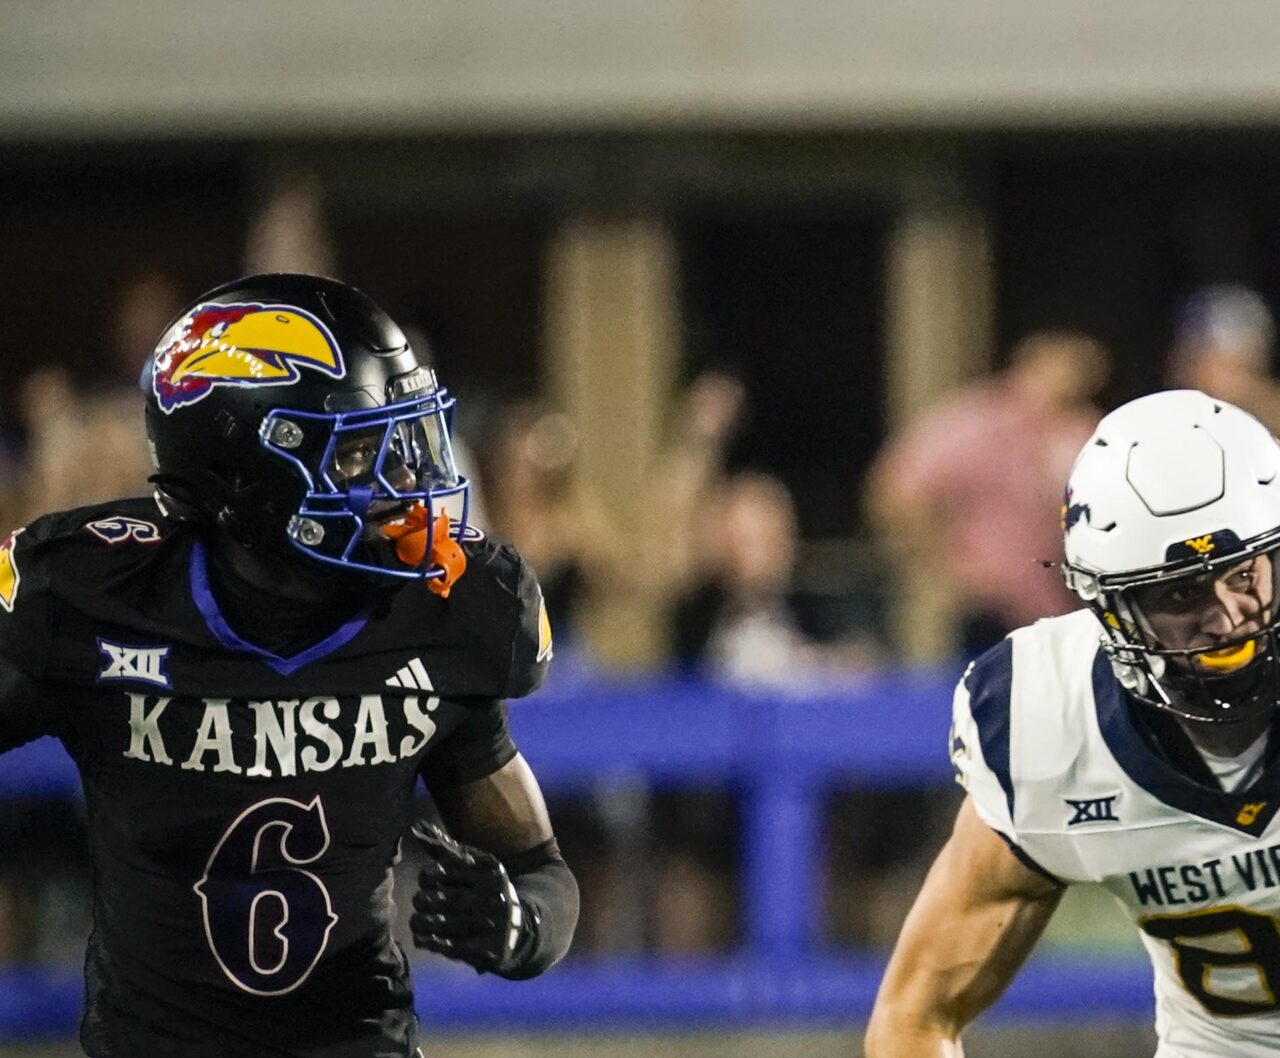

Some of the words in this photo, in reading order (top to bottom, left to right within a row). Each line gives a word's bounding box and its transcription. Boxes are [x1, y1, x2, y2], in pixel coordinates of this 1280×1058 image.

[123, 692, 443, 777] KANSAS
[193, 795, 339, 997] 6
[1130, 858, 1227, 906] WEST
